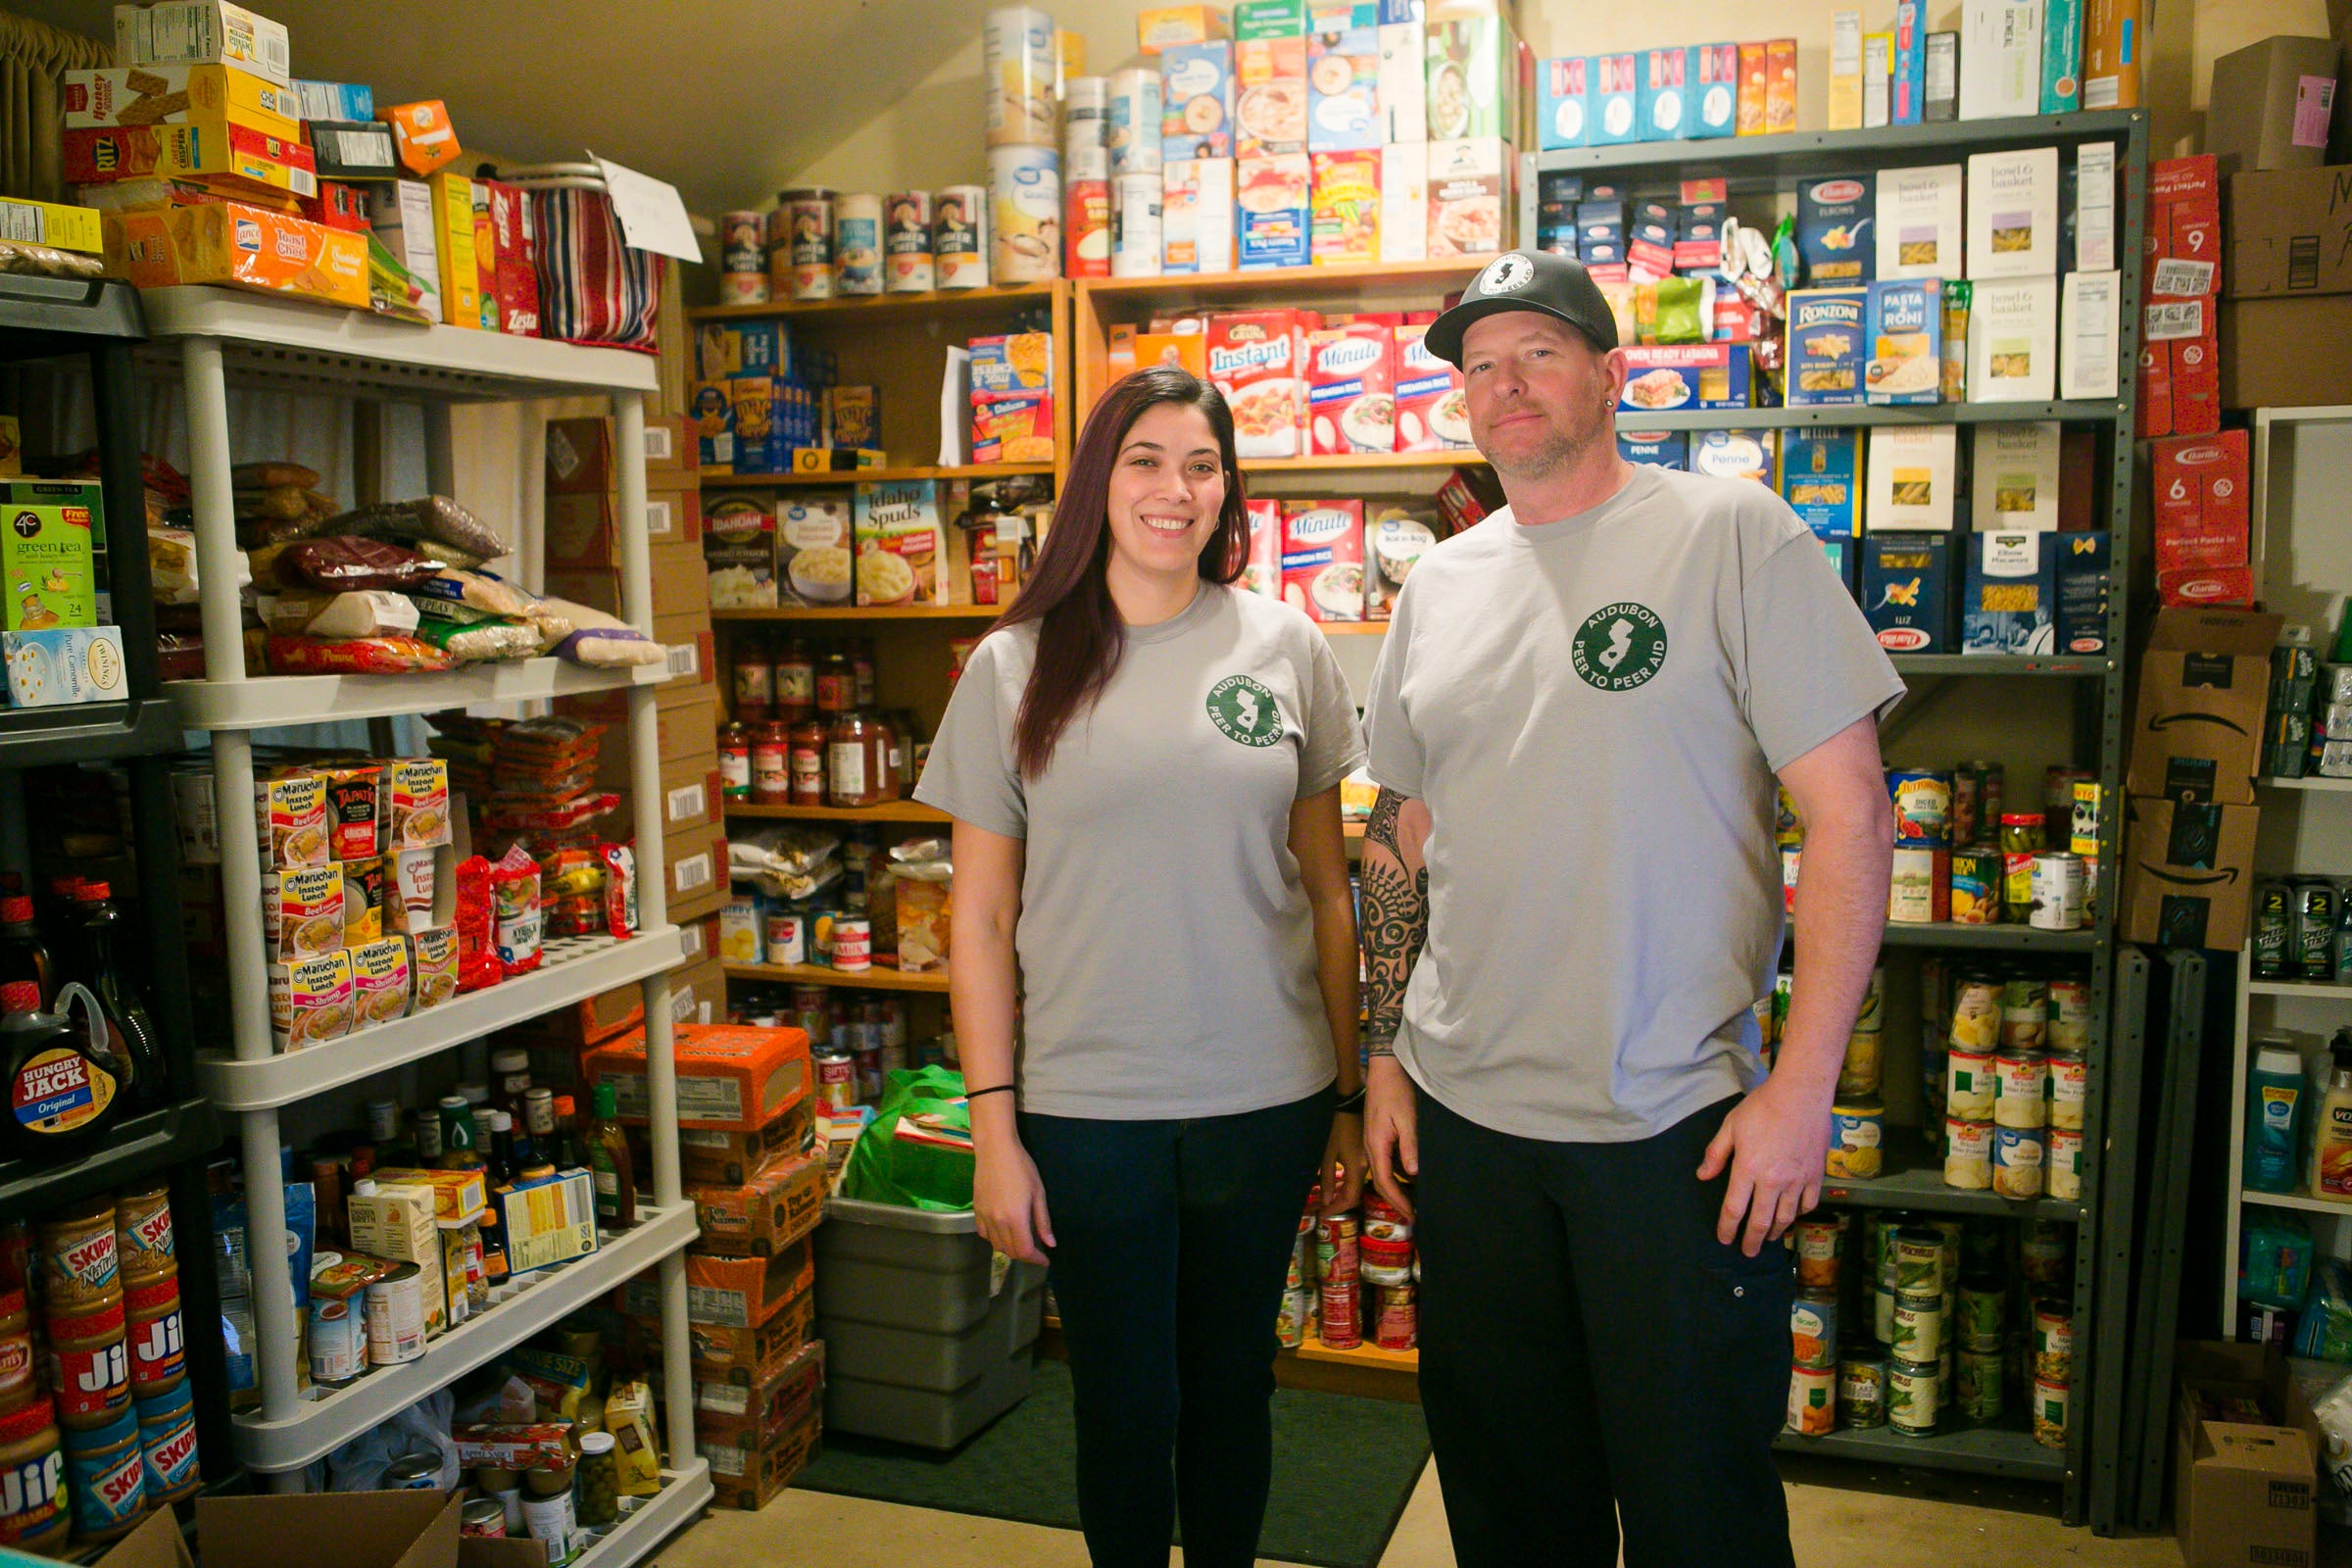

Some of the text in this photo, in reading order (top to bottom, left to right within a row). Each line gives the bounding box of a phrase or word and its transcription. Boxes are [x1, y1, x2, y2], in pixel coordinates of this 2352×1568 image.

[96, 135, 117, 173] RITZ
[178, 128, 187, 169] CRISPERS
[276, 228, 307, 246] Toast
[276, 242, 307, 260] Chee
[1884, 294, 1923, 307] PASTA
[508, 309, 538, 330] Zesta
[1798, 305, 1859, 323] RONZONI
[1213, 340, 1288, 371] Instant
[1321, 344, 1379, 368] Minute
[1626, 348, 1651, 361] OVEN
[1681, 347, 1719, 361] LASAGNA
[1630, 445, 1659, 456] PENNE
[1711, 453, 1750, 465] Penne
[2169, 478, 2186, 500] 6
[868, 487, 921, 509] Idaho
[65, 510, 89, 518] Free
[868, 504, 921, 528] Spuds
[711, 514, 762, 532] IDAHOAN
[1294, 513, 1351, 535] Minute
[17, 541, 81, 555] green tea
[70, 603, 81, 613] 24
[424, 600, 449, 613] PEAS
[1588, 604, 1659, 629] AUDUBON
[65, 634, 74, 653] Pure
[96, 643, 109, 686] TWININGS
[1573, 640, 1665, 689] PEER TO PEER AID
[1212, 676, 1271, 699] AUDUBON
[1208, 706, 1283, 746] PEER TO PEER AID
[405, 765, 443, 777] Maruchan
[281, 779, 323, 794] Maruchan
[407, 777, 435, 787] Instant
[411, 785, 432, 794] Lunch
[286, 793, 315, 805] Instant
[289, 802, 314, 812] Lunch
[295, 869, 338, 885] Maruchan
[298, 882, 329, 895] Instant
[416, 884, 432, 894] Lun
[302, 892, 326, 902] Lunch
[2268, 895, 2282, 909] 2
[2312, 897, 2328, 911] 2
[422, 928, 456, 946] Maruchan
[363, 943, 402, 959] Maruchan
[426, 941, 448, 953] Instant
[429, 949, 447, 959] Lunch
[302, 957, 345, 975] Maruchan
[367, 956, 394, 968] Instant
[370, 963, 393, 975] Lunch
[307, 971, 337, 985] Instant
[374, 973, 399, 988] Shrimp
[311, 981, 335, 993] Lunch
[315, 990, 341, 1006] Shrimp
[23, 1055, 80, 1083] HUNGRY
[23, 1066, 88, 1102] JACK
[38, 1093, 76, 1114] Original
[2335, 1110, 2352, 1122] VO
[142, 1208, 171, 1243] SKIP
[80, 1252, 119, 1289] Natura
[155, 1426, 196, 1471] SKIPP
[0, 1449, 63, 1517] Jif
